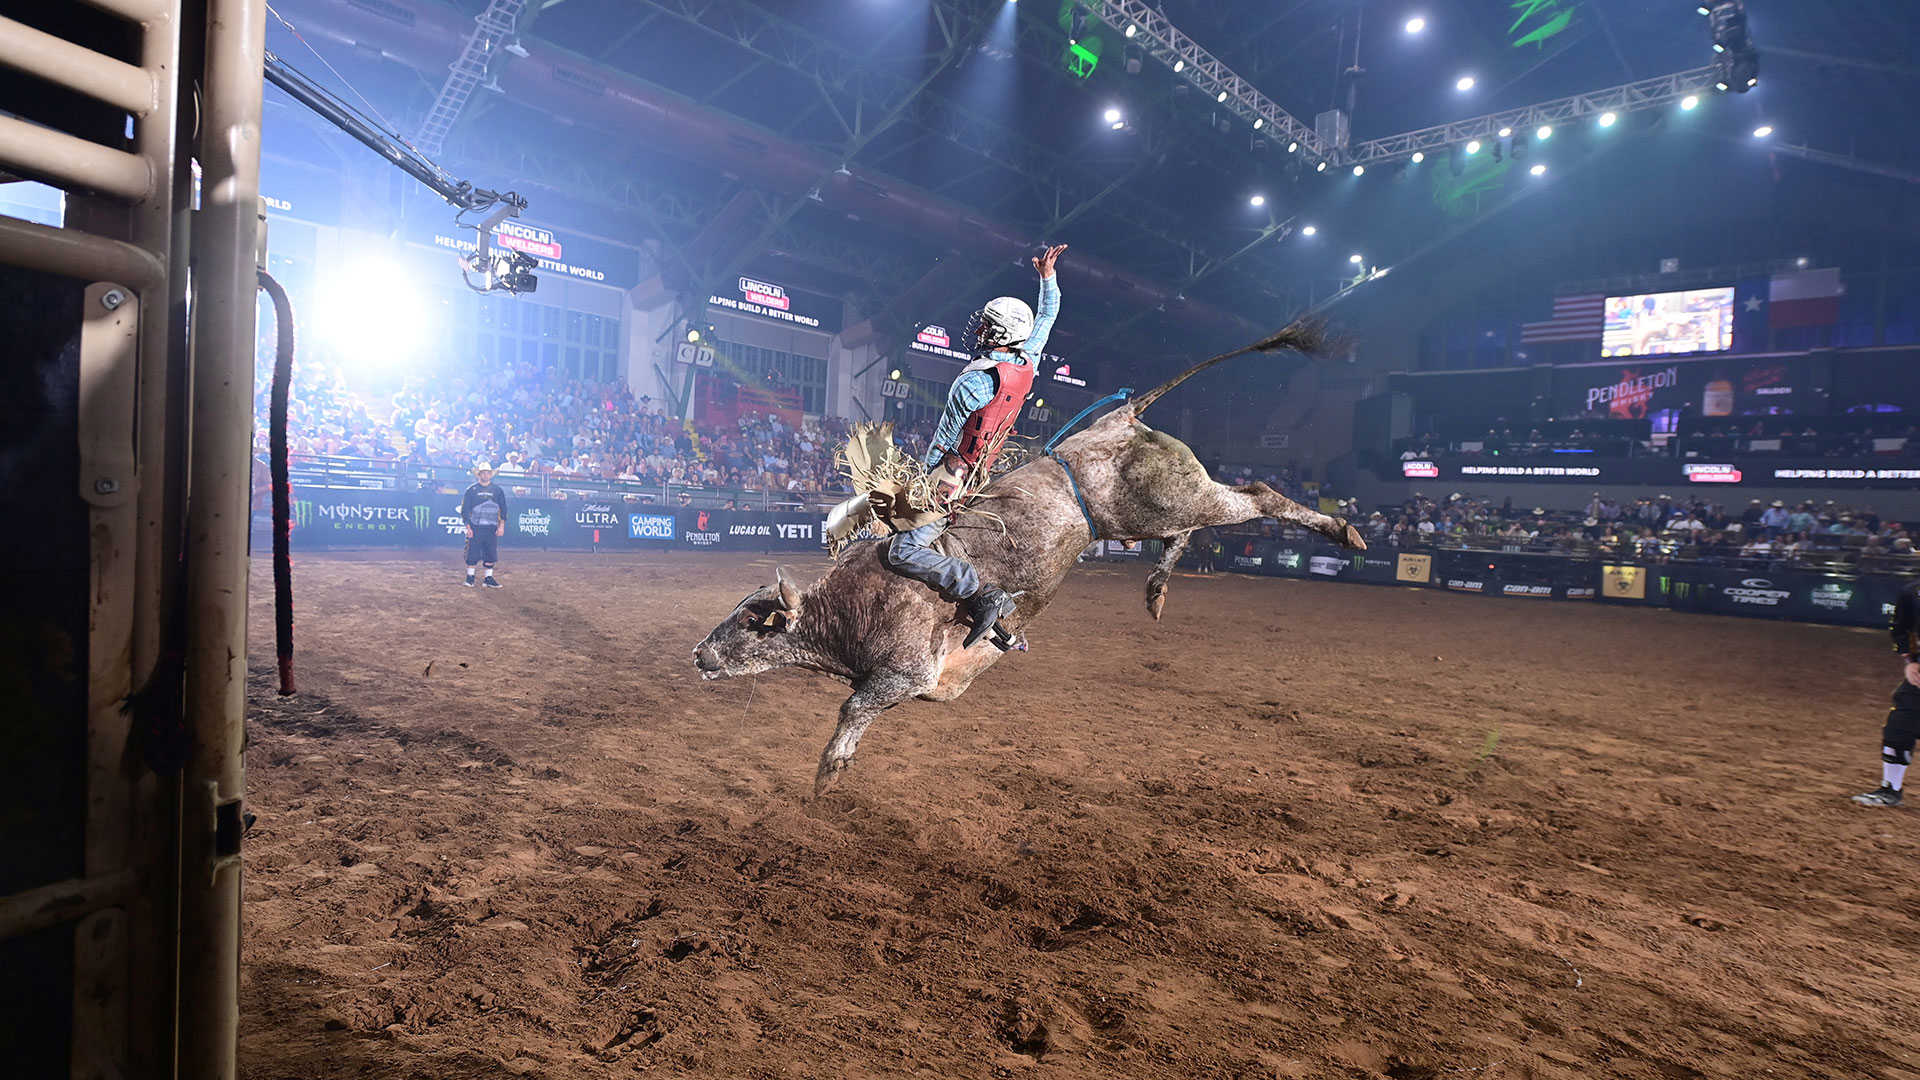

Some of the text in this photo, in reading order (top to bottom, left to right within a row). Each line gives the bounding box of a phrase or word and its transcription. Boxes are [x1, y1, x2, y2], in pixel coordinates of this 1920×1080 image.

[569, 265, 604, 280] WORLD
[741, 280, 781, 298] LINCOLN
[738, 302, 760, 314] BUILD
[768, 308, 793, 321] BETTER
[794, 314, 819, 327] WORLD
[1586, 367, 1678, 411] PENDLETON
[1462, 466, 1498, 475] HELPING
[1499, 467, 1524, 476] BUILD
[1534, 468, 1565, 476] BETTER
[1566, 468, 1600, 477] WORLD
[1774, 469, 1826, 479] HELPING
[1827, 469, 1865, 479] BUILD
[319, 502, 410, 521] MONSTER
[575, 512, 619, 525] ULTRA
[631, 515, 672, 527] CAMPING
[334, 522, 397, 531] ENERGY
[632, 525, 672, 537] WORLD
[729, 525, 771, 536] LUCAS OIL
[776, 523, 813, 539] YETI
[685, 531, 721, 543] PENDLETON
[1504, 584, 1552, 595] can-am
[1723, 587, 1791, 599] COOPER
[1732, 595, 1779, 606] TIRES
